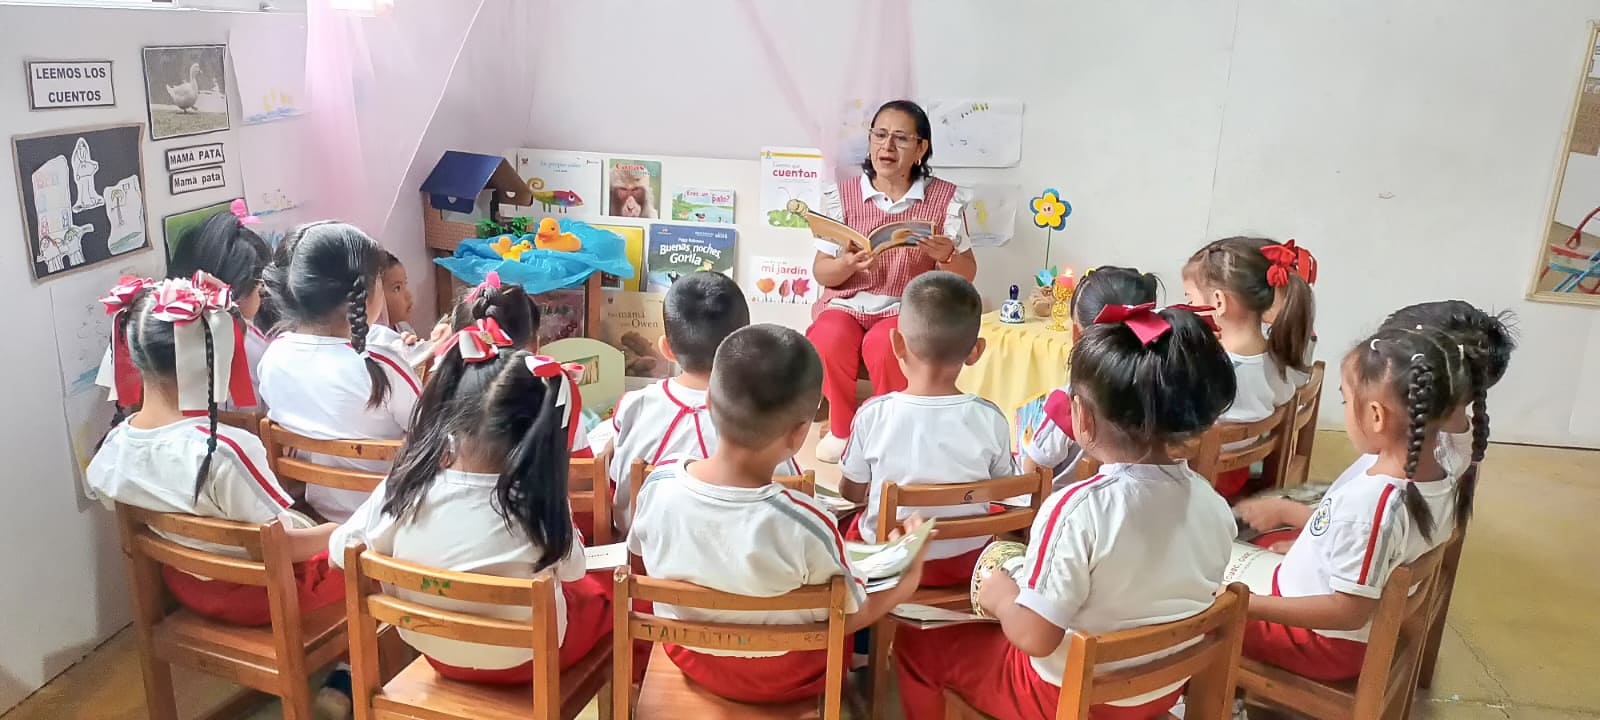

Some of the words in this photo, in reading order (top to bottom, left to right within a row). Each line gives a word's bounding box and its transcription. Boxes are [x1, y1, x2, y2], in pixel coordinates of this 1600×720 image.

[36, 67, 81, 79] LEEMOS
[84, 67, 106, 78] LOS
[48, 90, 101, 103] CUENTOS
[199, 148, 221, 160] PATA
[201, 172, 220, 184] pata
[772, 168, 817, 178] cuentan
[660, 243, 690, 255] Buenas
[669, 250, 702, 266] Gorila
[761, 264, 775, 273] mi
[631, 319, 658, 329] Owen
